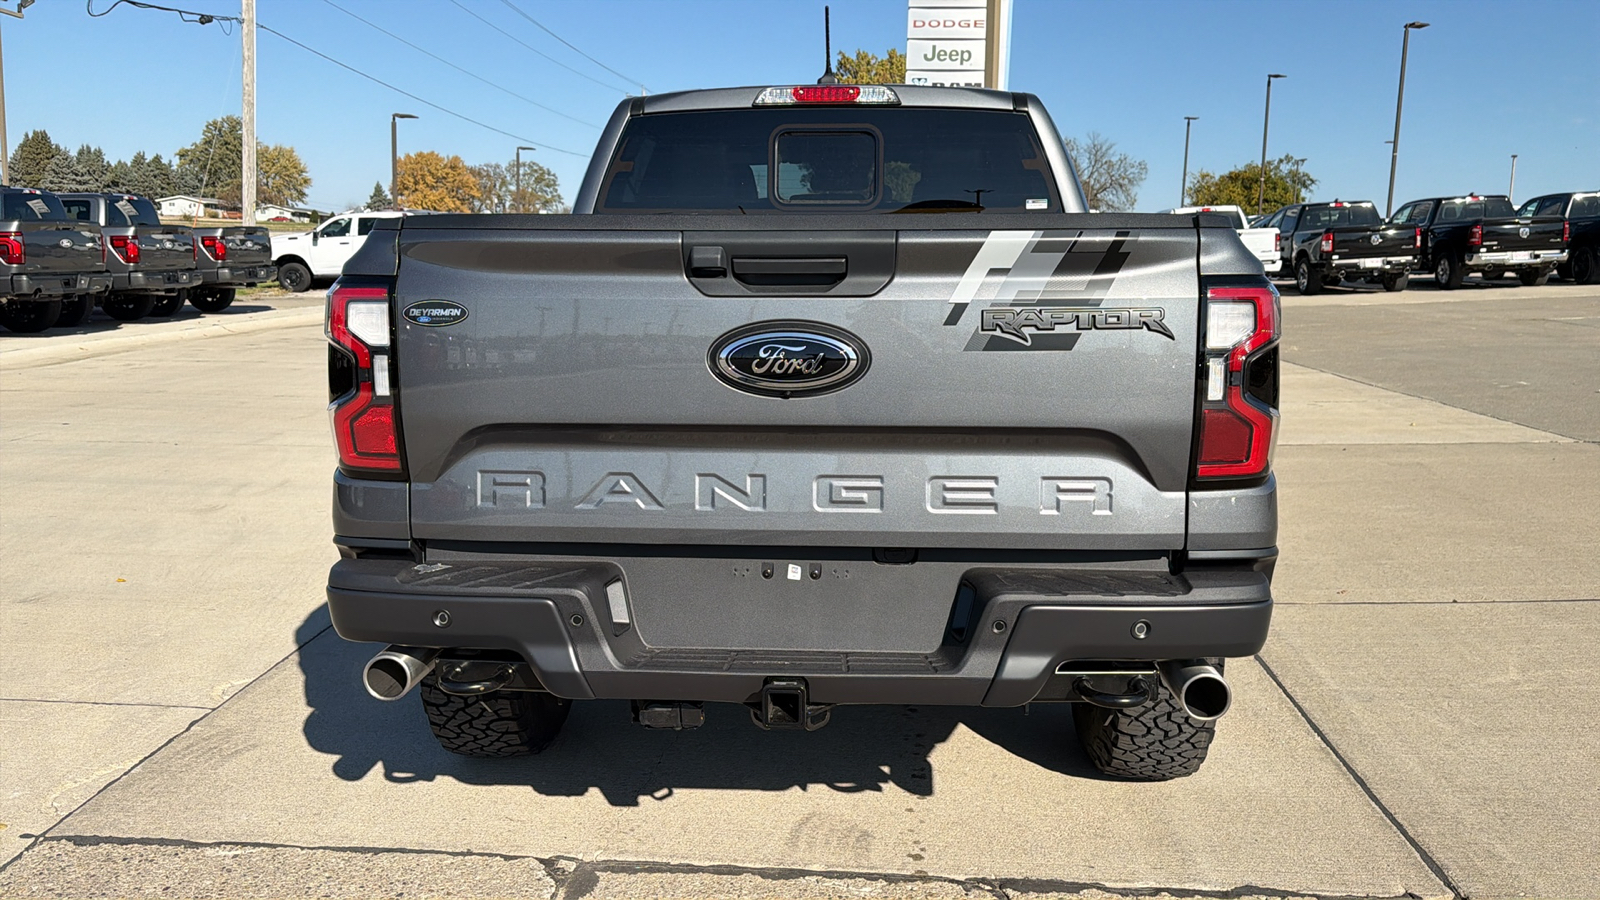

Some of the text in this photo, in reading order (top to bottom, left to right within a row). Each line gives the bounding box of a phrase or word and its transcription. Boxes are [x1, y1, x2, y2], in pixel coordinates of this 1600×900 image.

[913, 20, 985, 28] DODGE
[923, 45, 972, 65] Jeep
[409, 308, 462, 316] DEYARMAN
[980, 307, 1175, 343] RAPTOR
[752, 344, 823, 374] Ford
[476, 469, 1113, 515] RANGER
